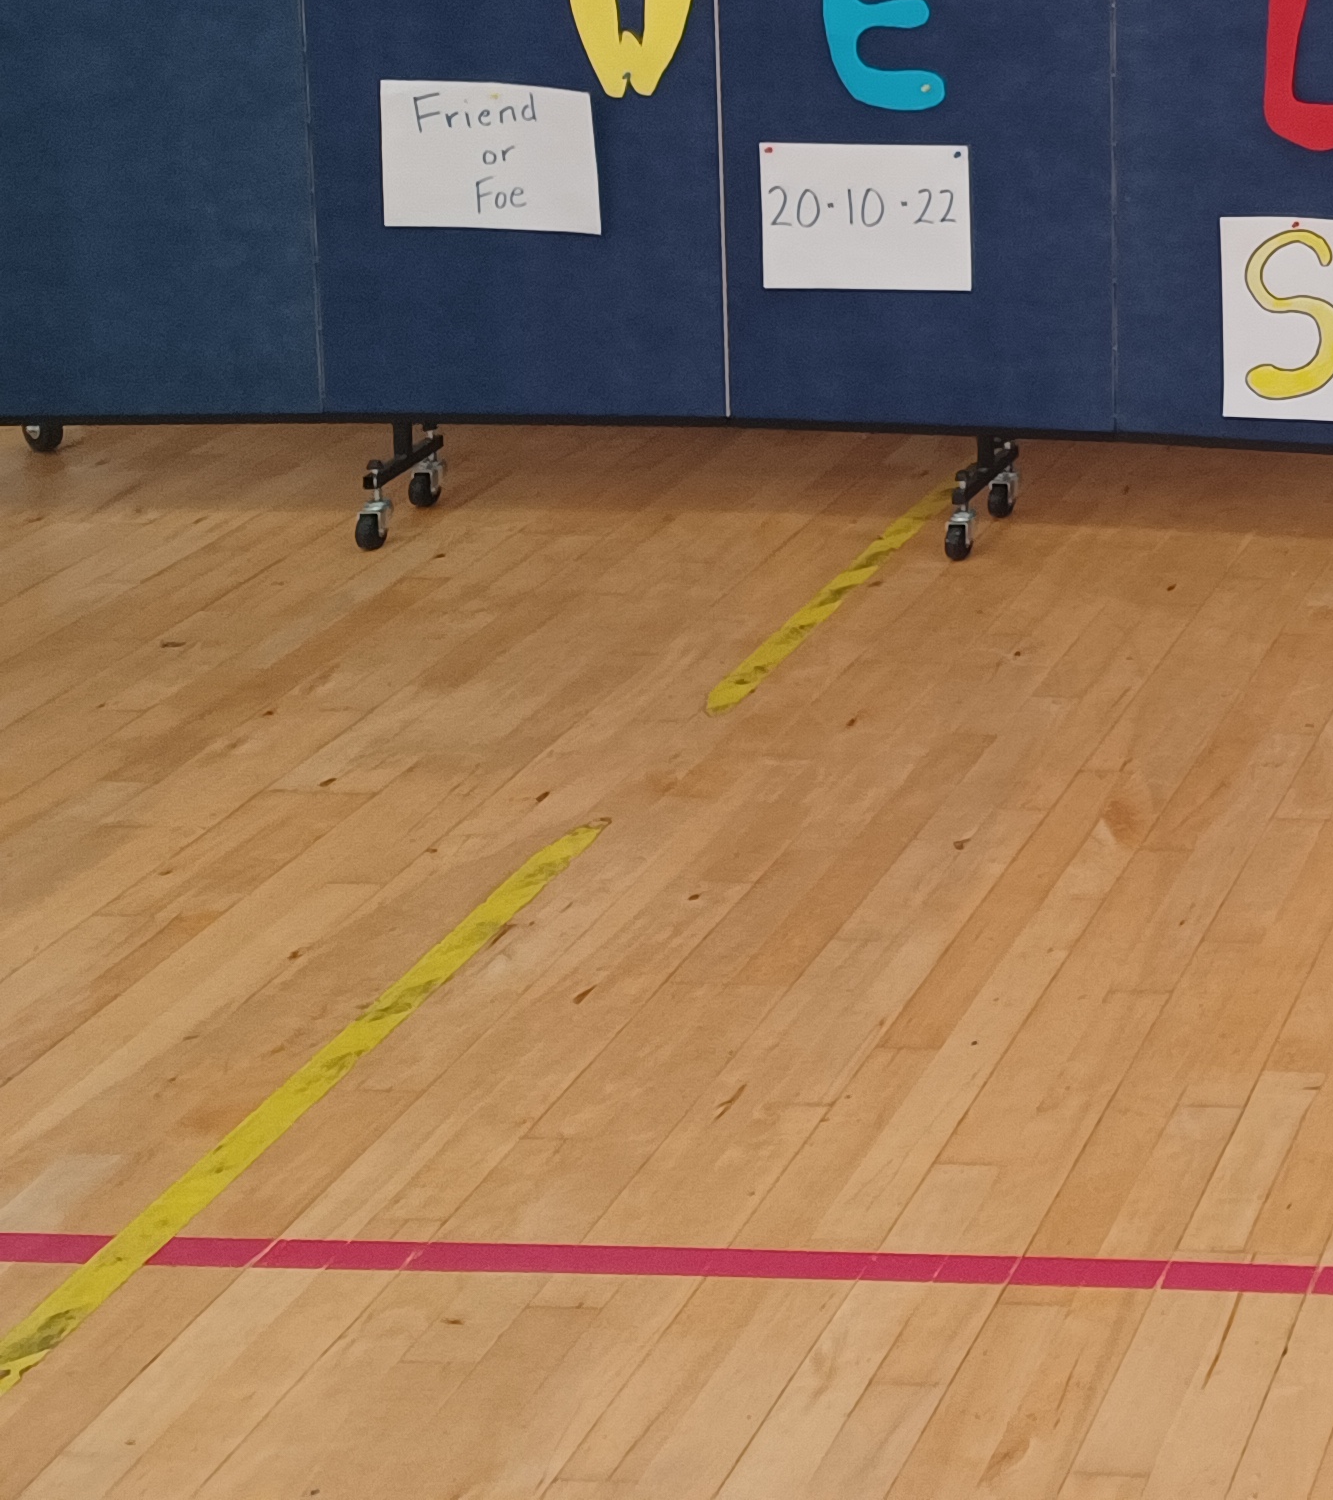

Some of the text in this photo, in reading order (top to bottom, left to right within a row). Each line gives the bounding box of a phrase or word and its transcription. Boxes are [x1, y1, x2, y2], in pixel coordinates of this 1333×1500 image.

[412, 92, 538, 133] Friend
[481, 141, 516, 167] or
[474, 178, 528, 216] Foe
